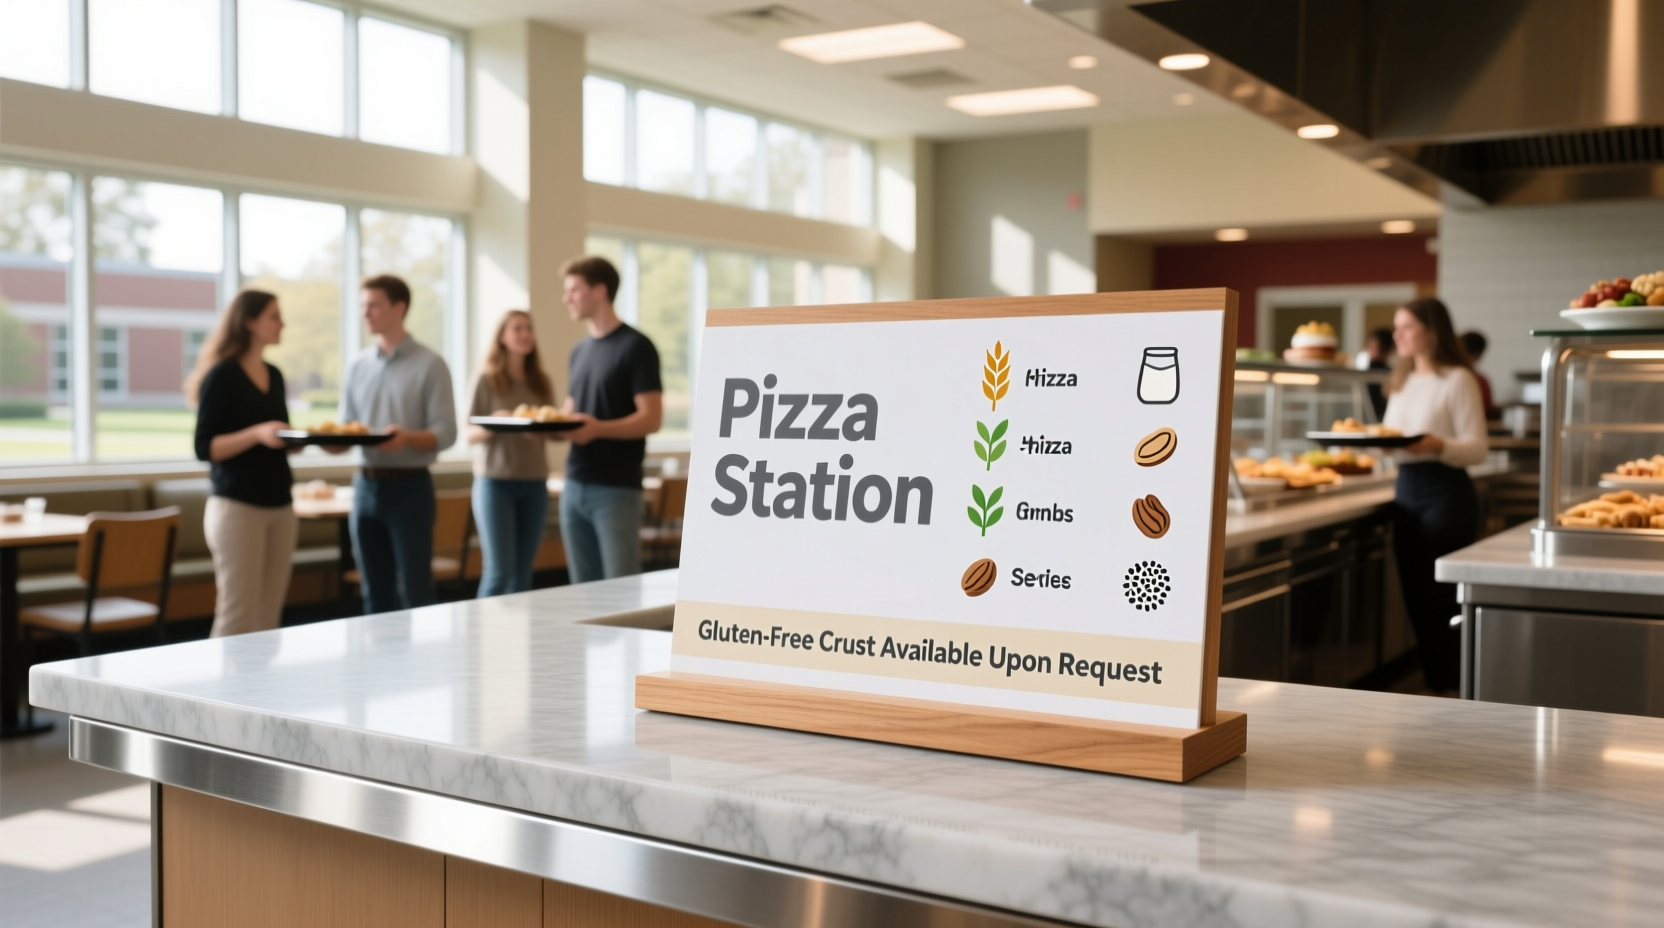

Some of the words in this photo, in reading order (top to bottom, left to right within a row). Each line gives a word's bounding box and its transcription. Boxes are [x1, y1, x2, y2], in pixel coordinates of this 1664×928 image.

[719, 373, 879, 442] Pizza
[710, 453, 934, 526] Station
[698, 619, 815, 651] Gluten-Free
[819, 630, 877, 657] Crust
[879, 636, 983, 667] Available
[989, 645, 1052, 678] Upon
[1058, 652, 1163, 687] Request
